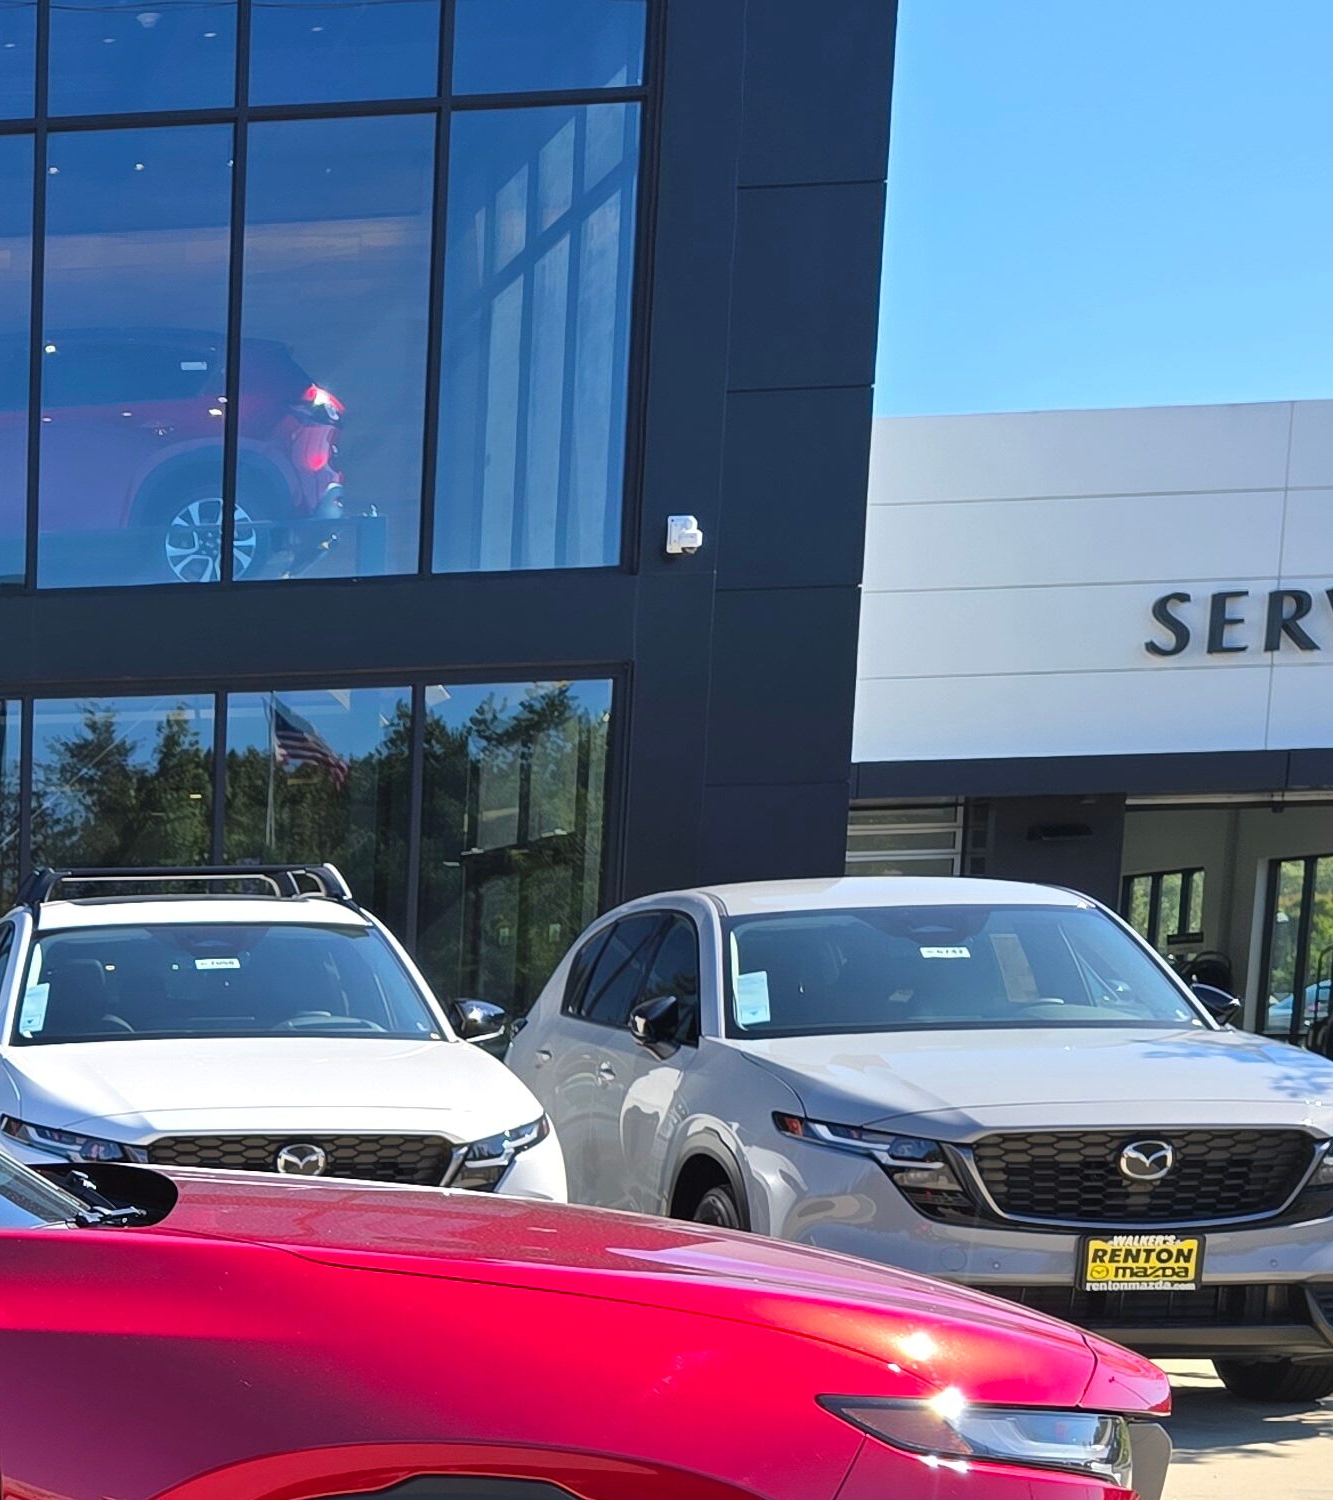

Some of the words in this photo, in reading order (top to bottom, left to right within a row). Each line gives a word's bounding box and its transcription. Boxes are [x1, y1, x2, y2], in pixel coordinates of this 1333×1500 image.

[1144, 587, 1333, 657] SER
[1091, 1248, 1194, 1264] RENTON
[1085, 1280, 1196, 1291] rentonmazda.com
